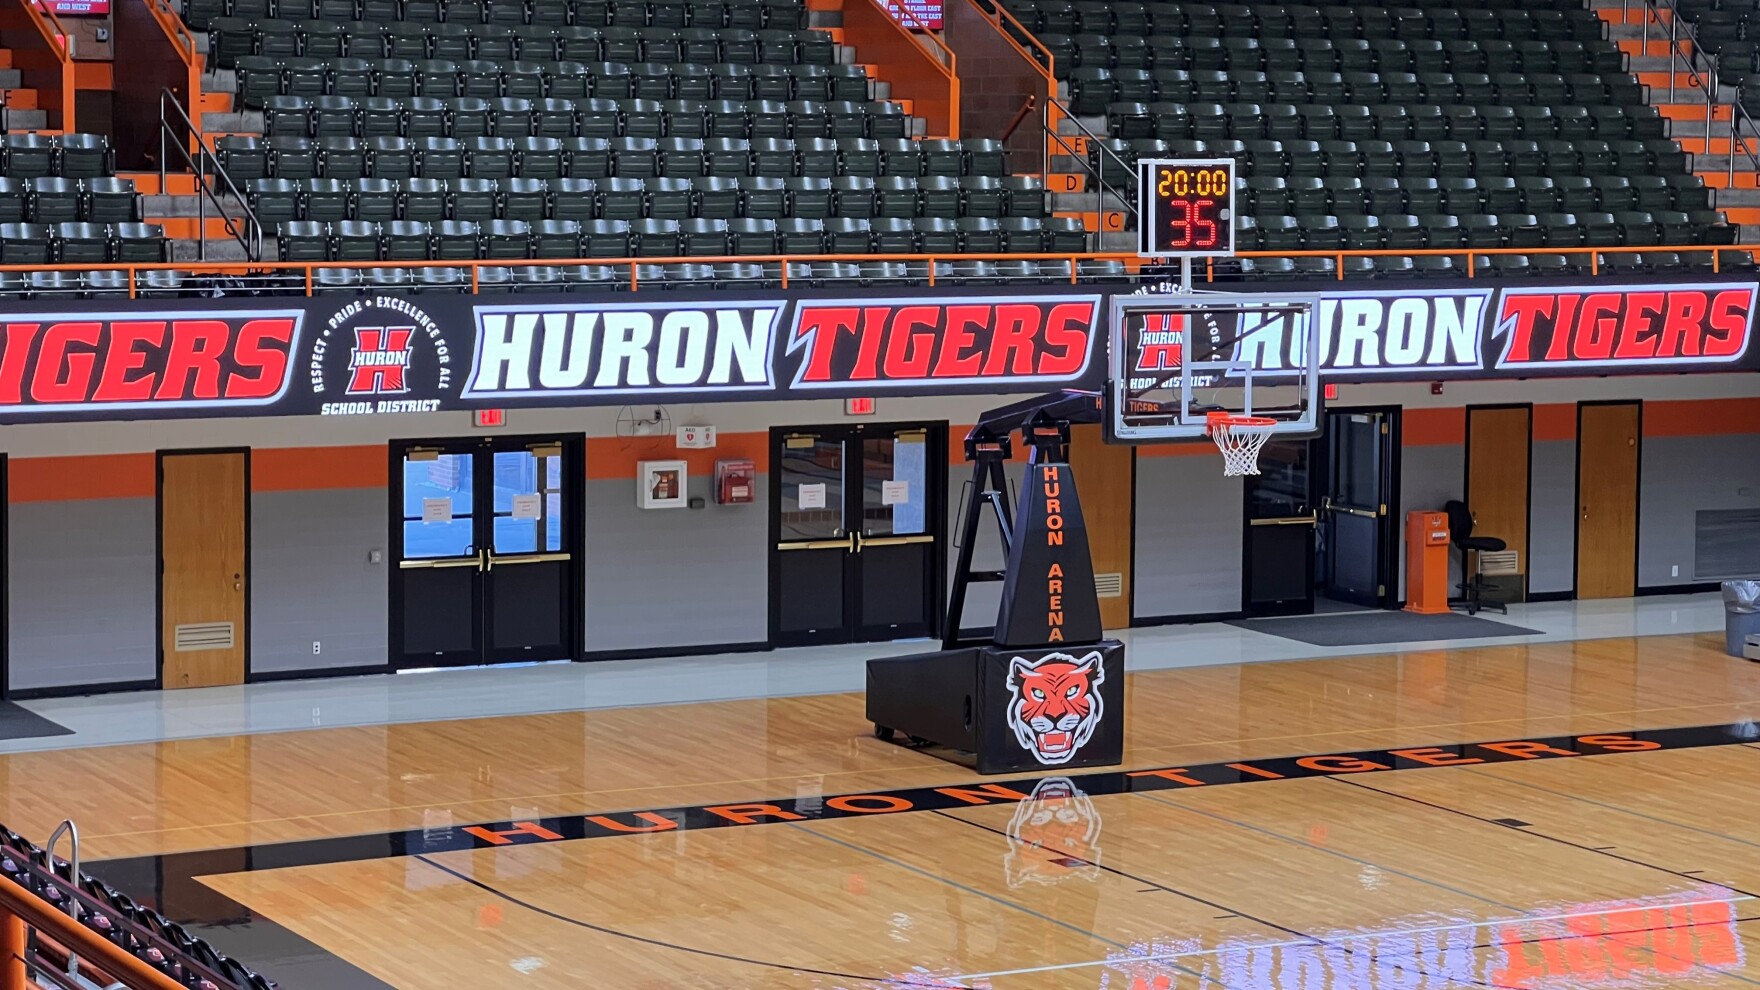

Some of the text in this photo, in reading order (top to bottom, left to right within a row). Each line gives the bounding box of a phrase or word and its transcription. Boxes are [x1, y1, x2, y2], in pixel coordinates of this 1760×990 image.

[1711, 106, 1719, 120] F
[1075, 137, 1082, 153] E
[1066, 176, 1077, 190] D
[1159, 170, 1226, 196] 20:00
[1108, 213, 1119, 228] C
[1171, 200, 1216, 247] 35
[1502, 290, 1751, 362] TIGERS
[0, 319, 294, 404] IGERS
[310, 296, 451, 393] RESPECT PRIDE EXCELLENCE FOR ALL
[354, 351, 407, 366] HURON
[473, 303, 1093, 390] HURON TIGERS
[321, 399, 441, 415] SCHOOL DISTRICT
[1043, 466, 1064, 642] HURON ARENA
[462, 733, 1662, 845] HURON TIGERS
